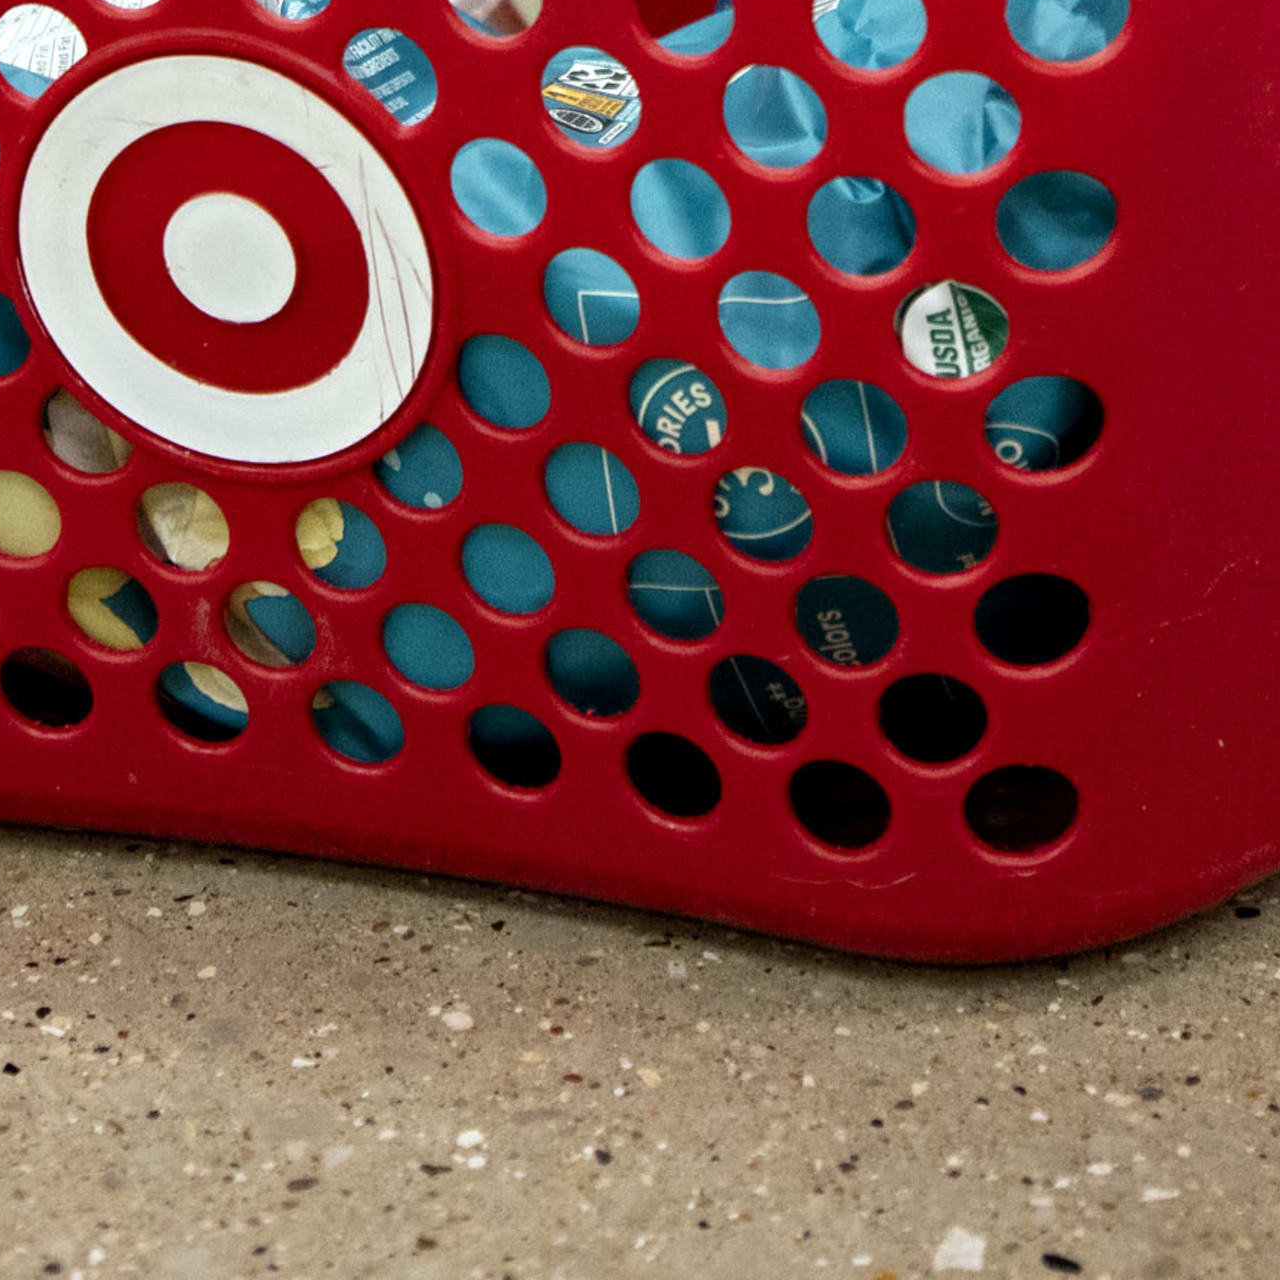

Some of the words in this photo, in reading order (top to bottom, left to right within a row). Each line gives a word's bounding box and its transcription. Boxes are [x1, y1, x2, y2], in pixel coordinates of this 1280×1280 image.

[926, 307, 961, 378] USDA
[957, 294, 992, 372] RGANIC
[658, 382, 712, 454] ORIES
[816, 609, 860, 666] olors
